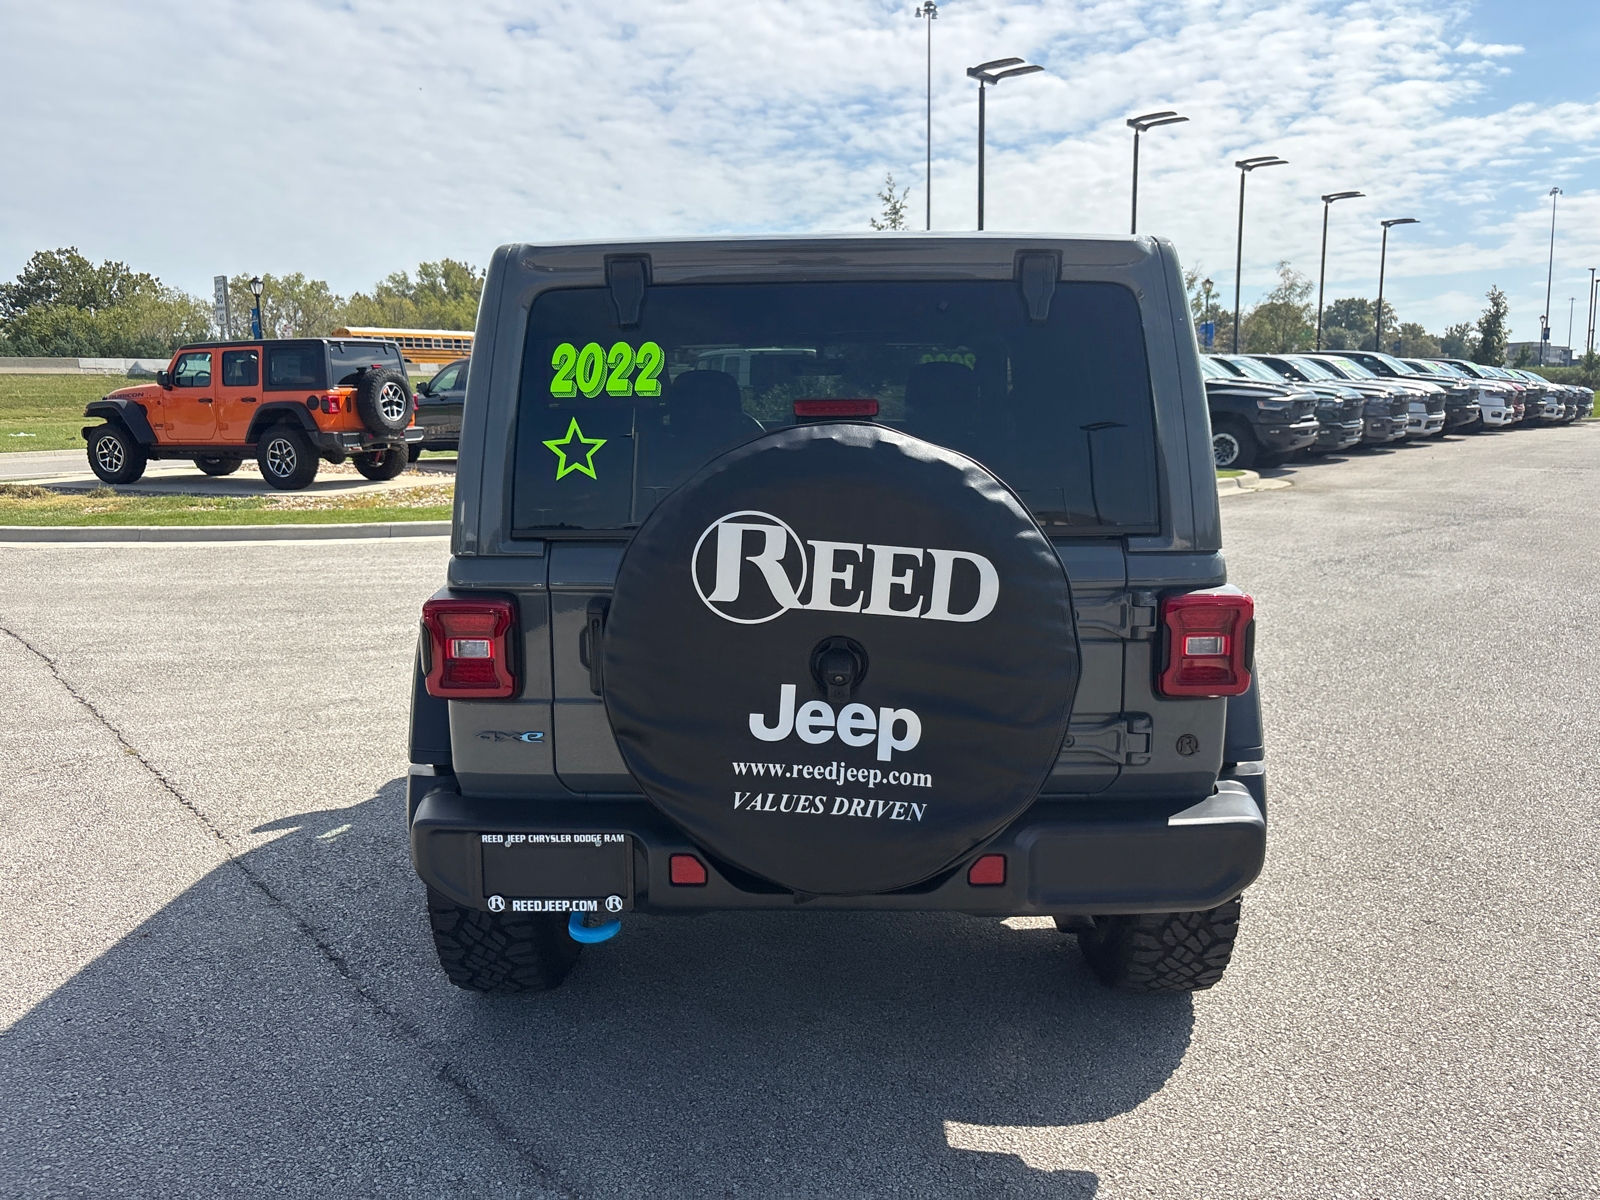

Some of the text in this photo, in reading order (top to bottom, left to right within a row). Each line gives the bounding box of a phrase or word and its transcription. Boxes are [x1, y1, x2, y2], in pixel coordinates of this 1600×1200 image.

[216, 294, 223, 304] 60
[550, 341, 665, 398] 2022
[691, 510, 1000, 625] REED
[749, 684, 922, 762] Jeep
[732, 761, 933, 788] www.reedjeep.com
[733, 791, 928, 822] VALUES DRIVEN
[481, 834, 625, 843] REED JEEP CHRYSLER DODGE RAM
[512, 900, 598, 912] REEDJEEP.COM
